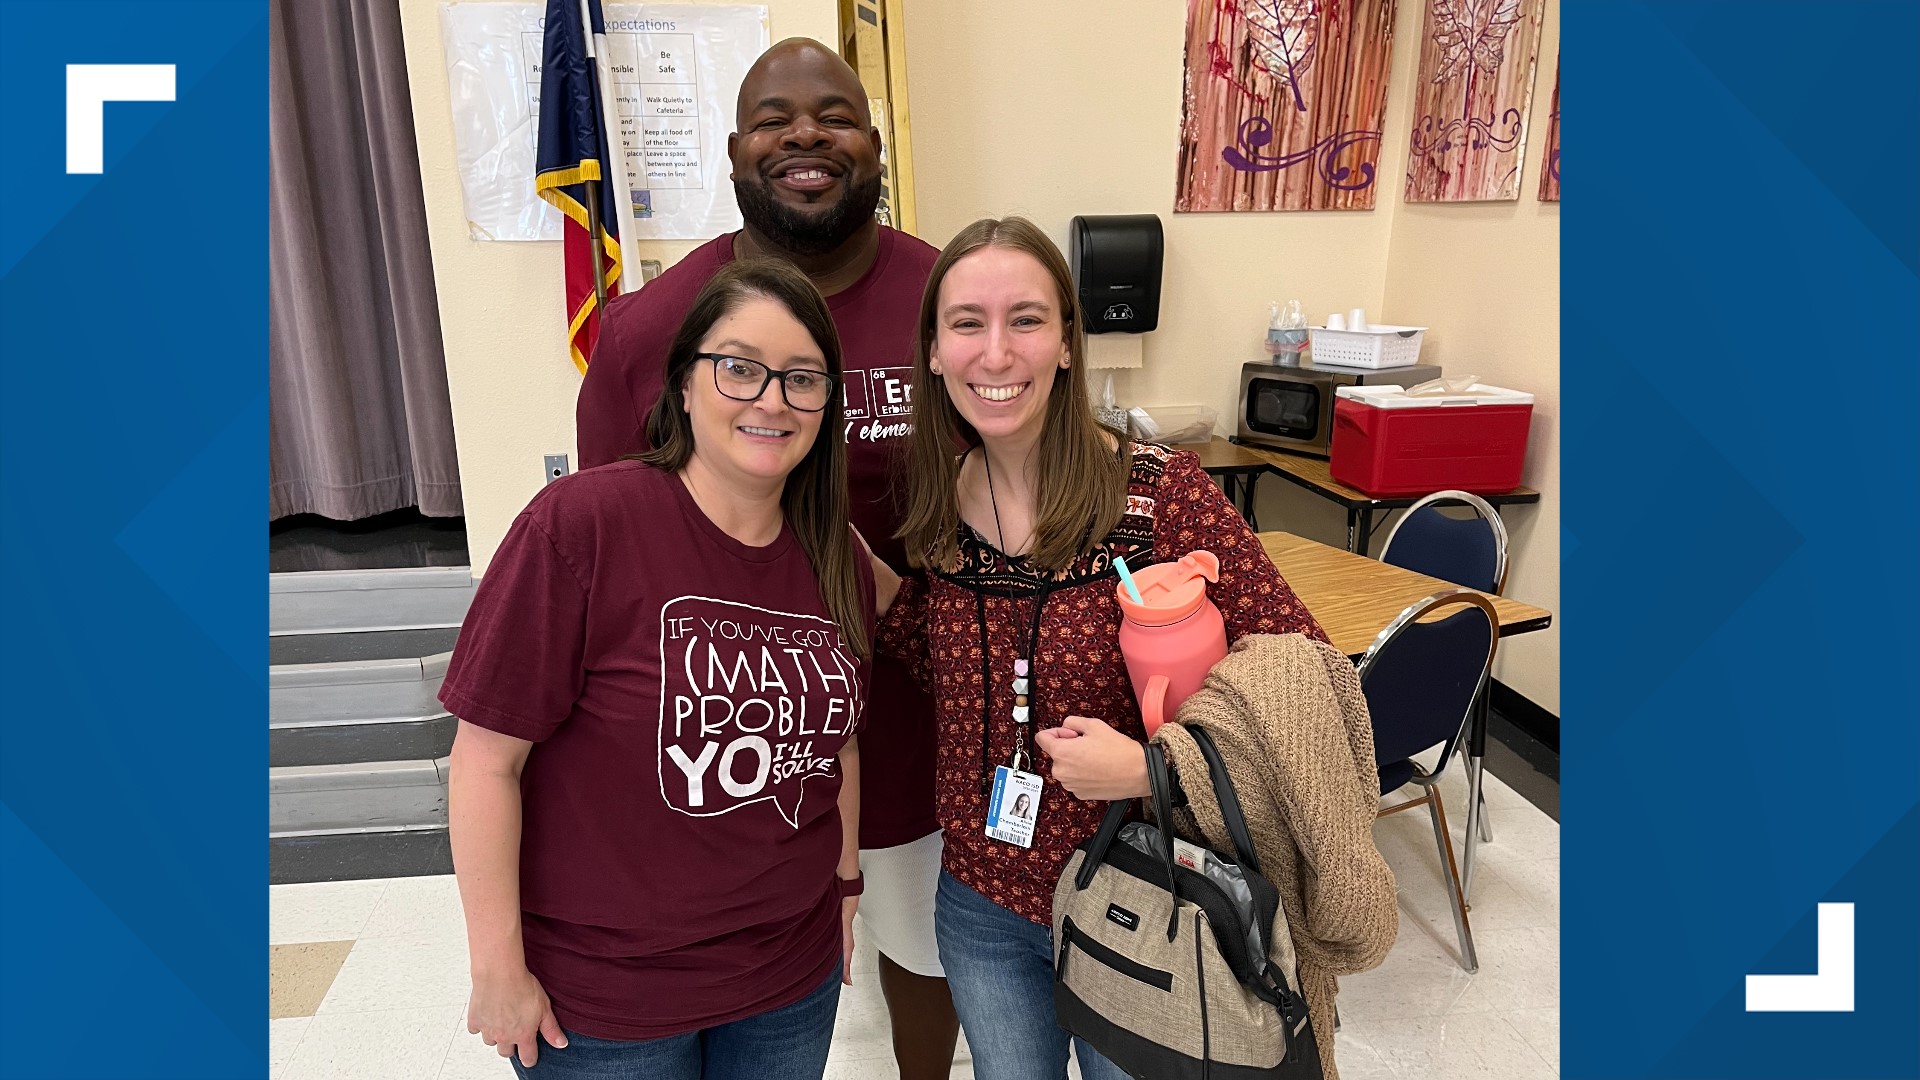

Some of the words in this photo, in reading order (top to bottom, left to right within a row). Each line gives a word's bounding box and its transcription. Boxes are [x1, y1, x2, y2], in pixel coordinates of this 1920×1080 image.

[604, 18, 676, 33] xpectations
[660, 51, 671, 59] Be
[611, 65, 634, 73] nsible
[658, 65, 676, 73] Safe
[662, 96, 685, 104] Quietly
[872, 370, 886, 379] 68
[884, 378, 913, 404] Er
[668, 616, 694, 639] IF
[700, 616, 789, 645] YOU'VE
[791, 630, 831, 648] GOT
[772, 740, 814, 763] I'LL
[665, 734, 772, 807] YO
[772, 757, 835, 785] SOLVE
